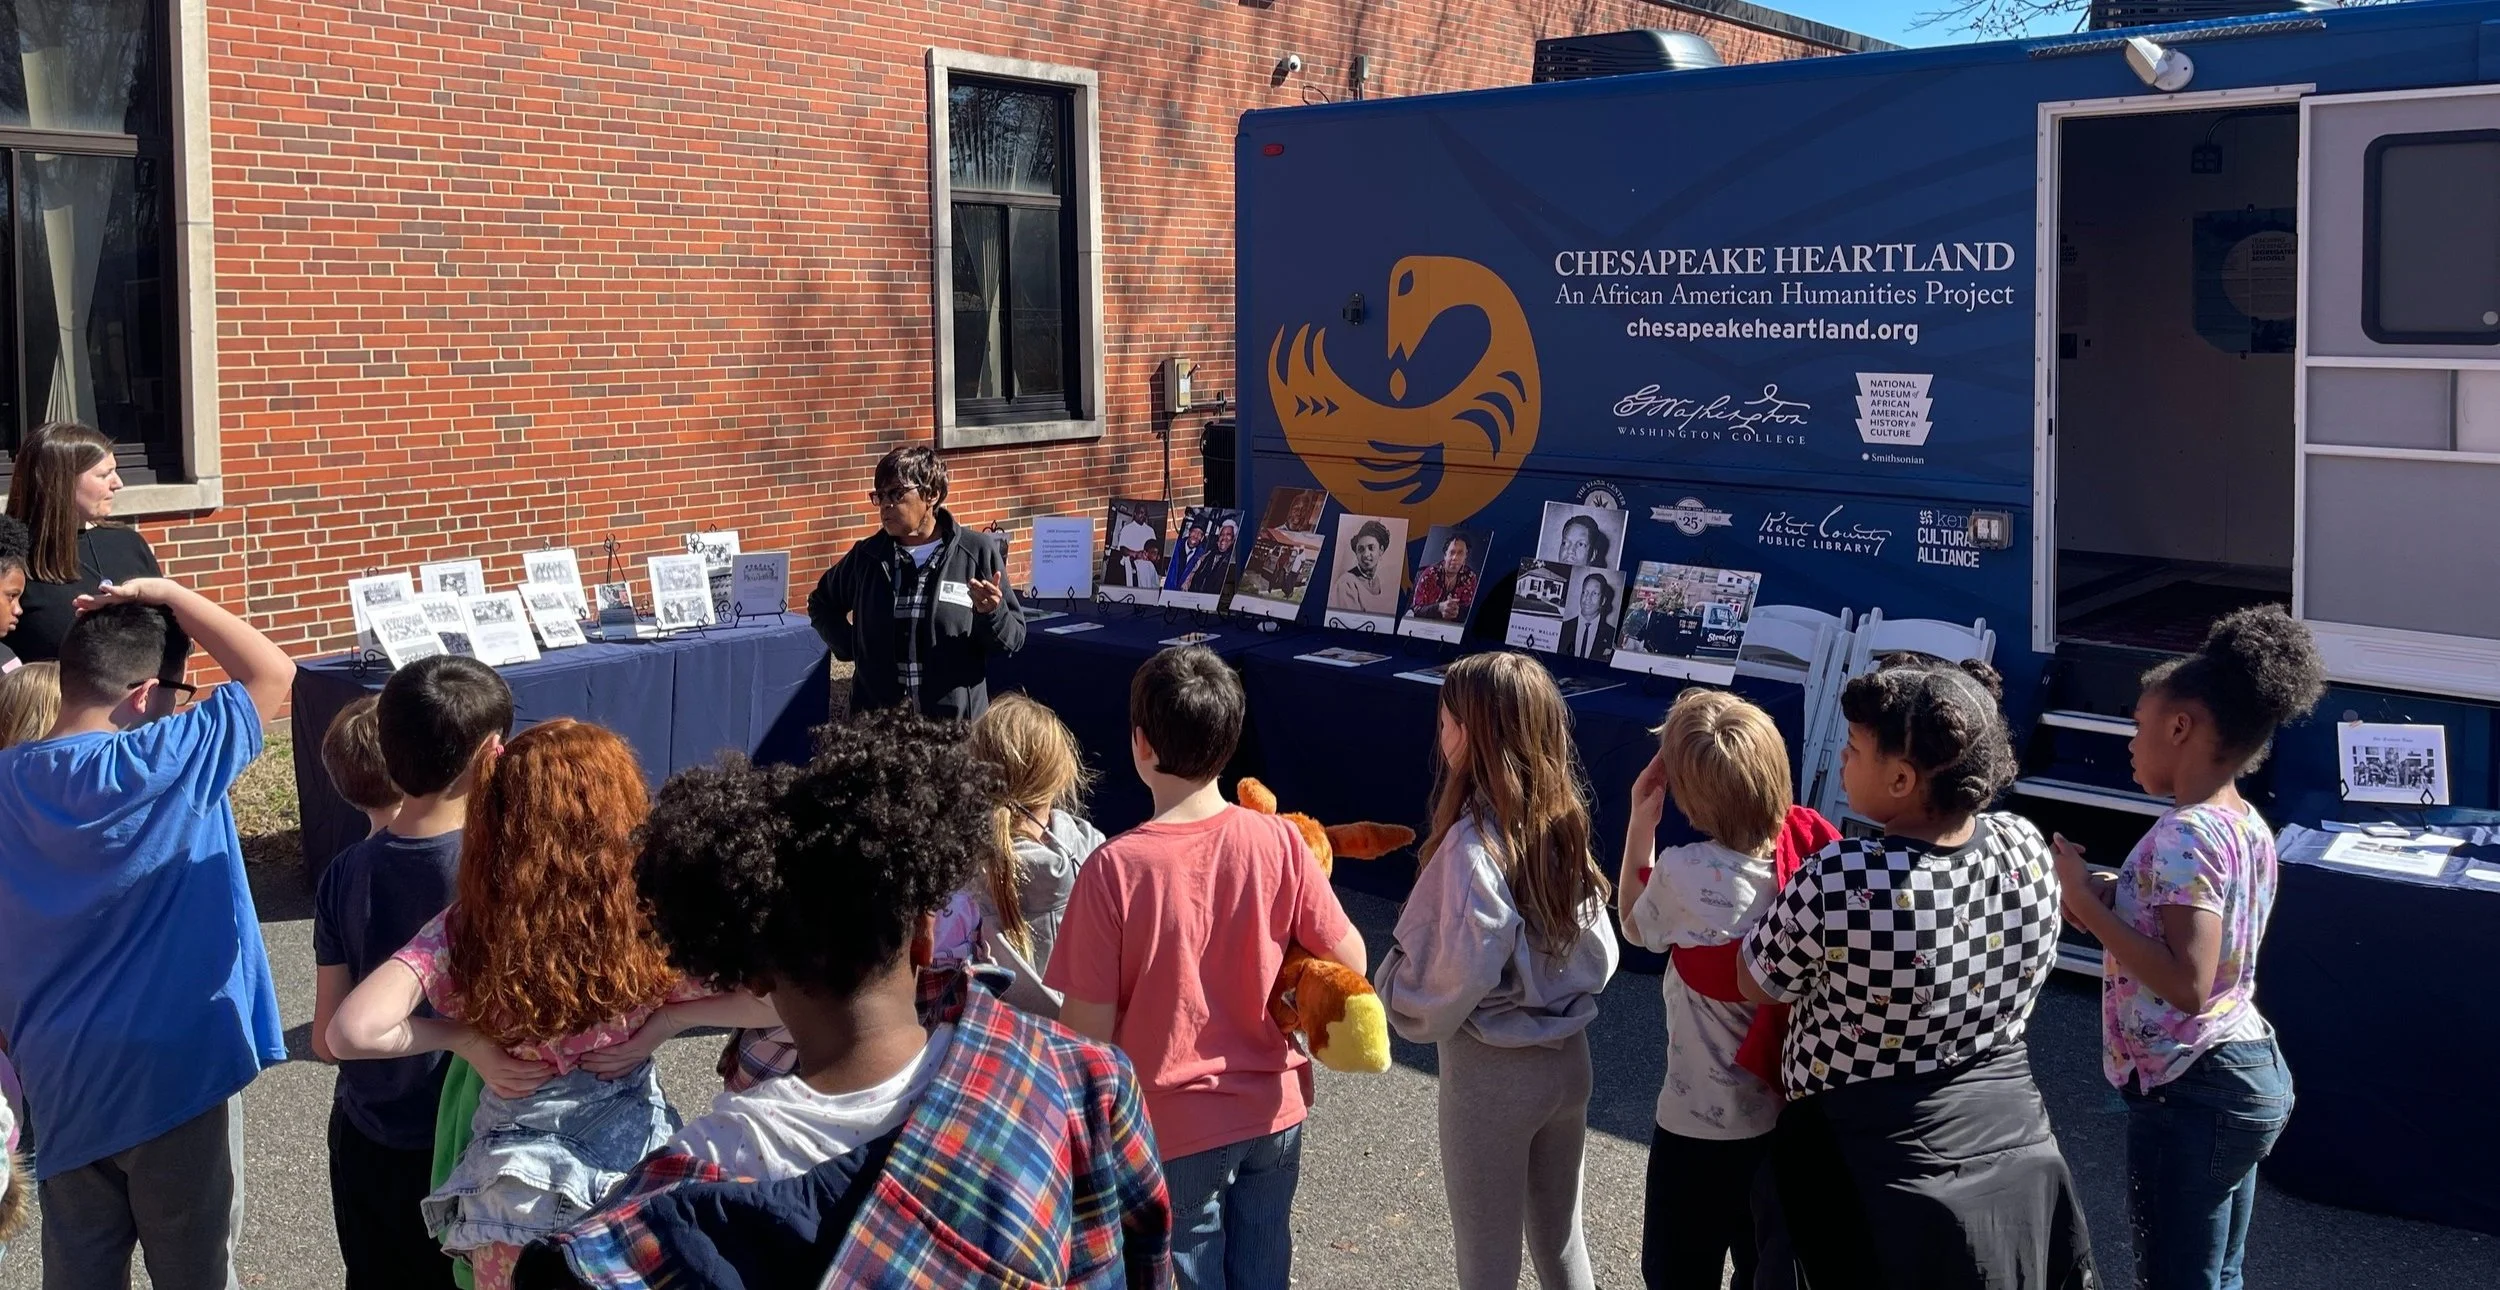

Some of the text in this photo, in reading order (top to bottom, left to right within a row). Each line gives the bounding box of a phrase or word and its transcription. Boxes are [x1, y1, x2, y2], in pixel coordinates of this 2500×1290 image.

[1554, 242, 2016, 276] CHESAPEAKE HEARTLAND
[1555, 280, 2015, 312] An African American Humanities Project
[1626, 317, 1919, 345] chesapeakeheartland.org
[1870, 380, 1917, 388] NATIONAL
[1870, 390, 1911, 398] MUSEUM
[1870, 399, 1910, 408] AFRICAN
[1870, 409, 1919, 418] AMERICAN
[1870, 419, 1909, 427] HISTORY
[1618, 426, 1806, 445] WASHINGTON COLLEGE
[1870, 428, 1911, 437] CULTURE
[1871, 453, 1924, 464] Smithsonian
[1576, 485, 1586, 499] THE
[1606, 482, 1626, 506] CENTER
[1682, 516, 1698, 530] 25
[1759, 504, 1892, 557] Kent County
[1758, 535, 1871, 553] PUBLIC LIBRARY
[1917, 546, 1980, 568] ALLIANCE
